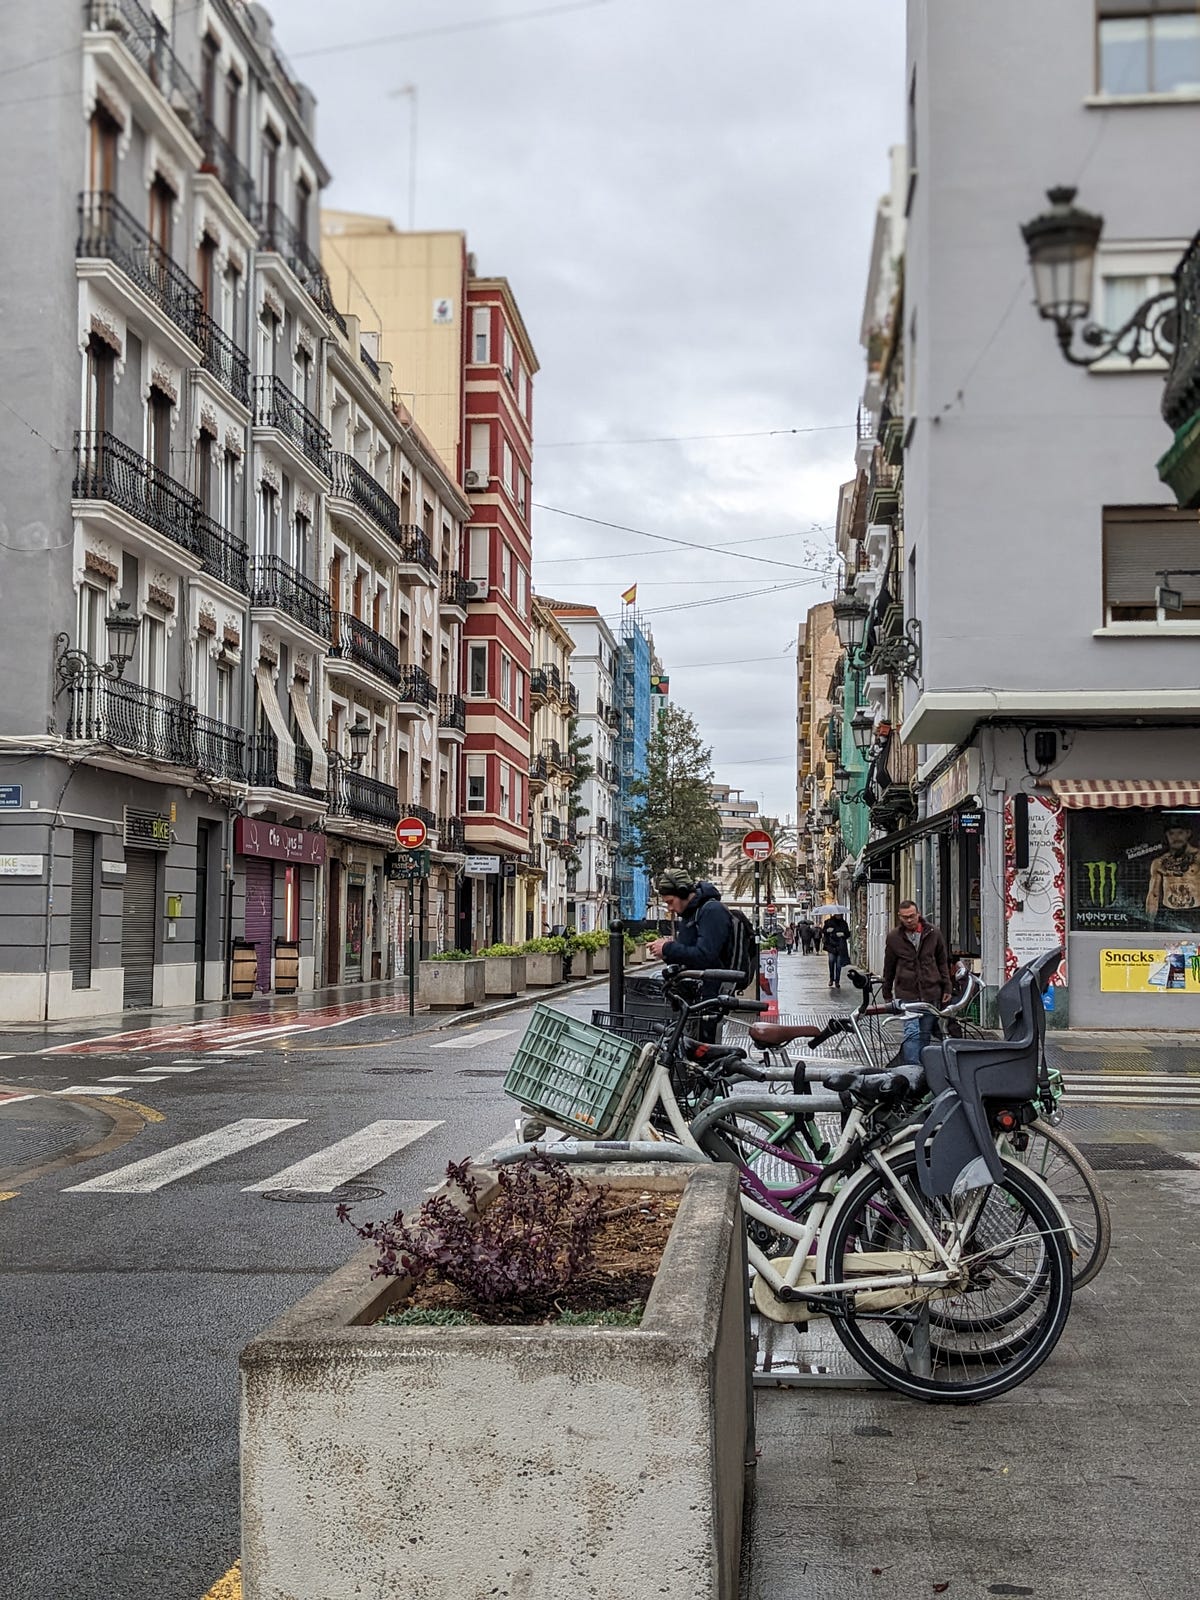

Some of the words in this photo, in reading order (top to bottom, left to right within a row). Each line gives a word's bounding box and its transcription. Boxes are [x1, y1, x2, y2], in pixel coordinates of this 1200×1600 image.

[152, 819, 169, 840] BIKE
[0, 857, 18, 868] IKE
[503, 864, 515, 876] P
[1076, 911, 1129, 922] MONSTER
[1105, 951, 1155, 963] Snacks
